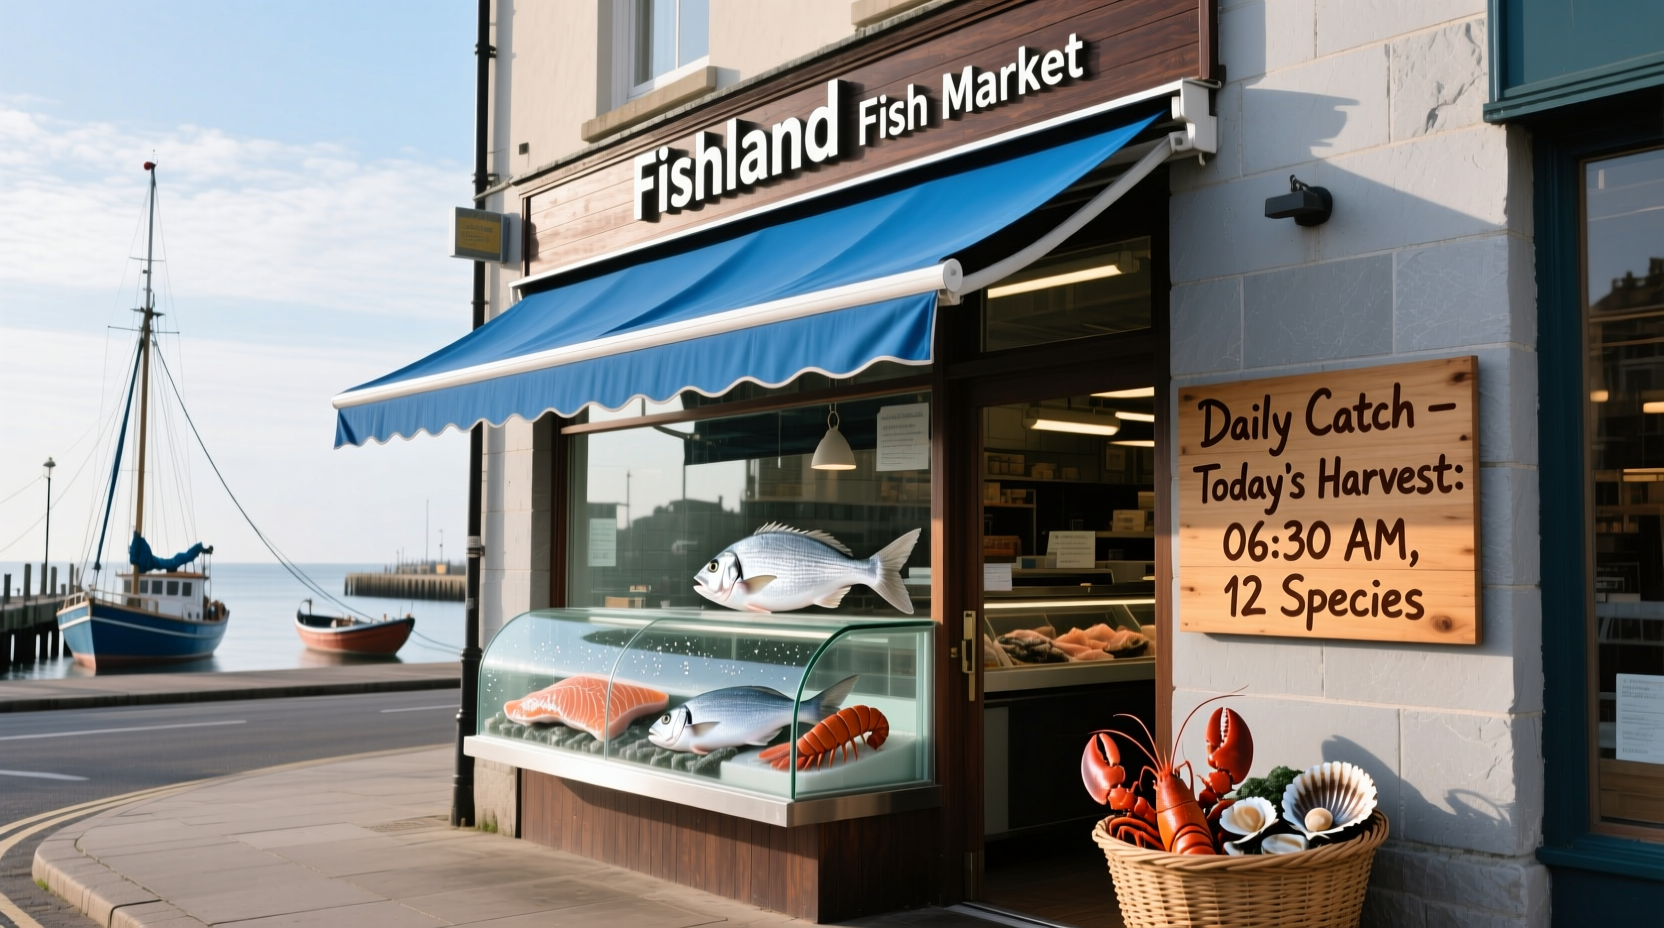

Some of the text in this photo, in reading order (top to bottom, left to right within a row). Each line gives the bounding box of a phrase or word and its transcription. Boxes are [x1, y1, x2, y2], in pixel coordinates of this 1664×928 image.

[633, 32, 1085, 221] Fishland Fish Market
[1197, 394, 1292, 457] Daily
[1305, 382, 1415, 436] Catch
[1192, 453, 1464, 516] Today's Harvest:
[1222, 517, 1420, 567] 06:30 AM,
[1223, 572, 1425, 632] 12 Species
